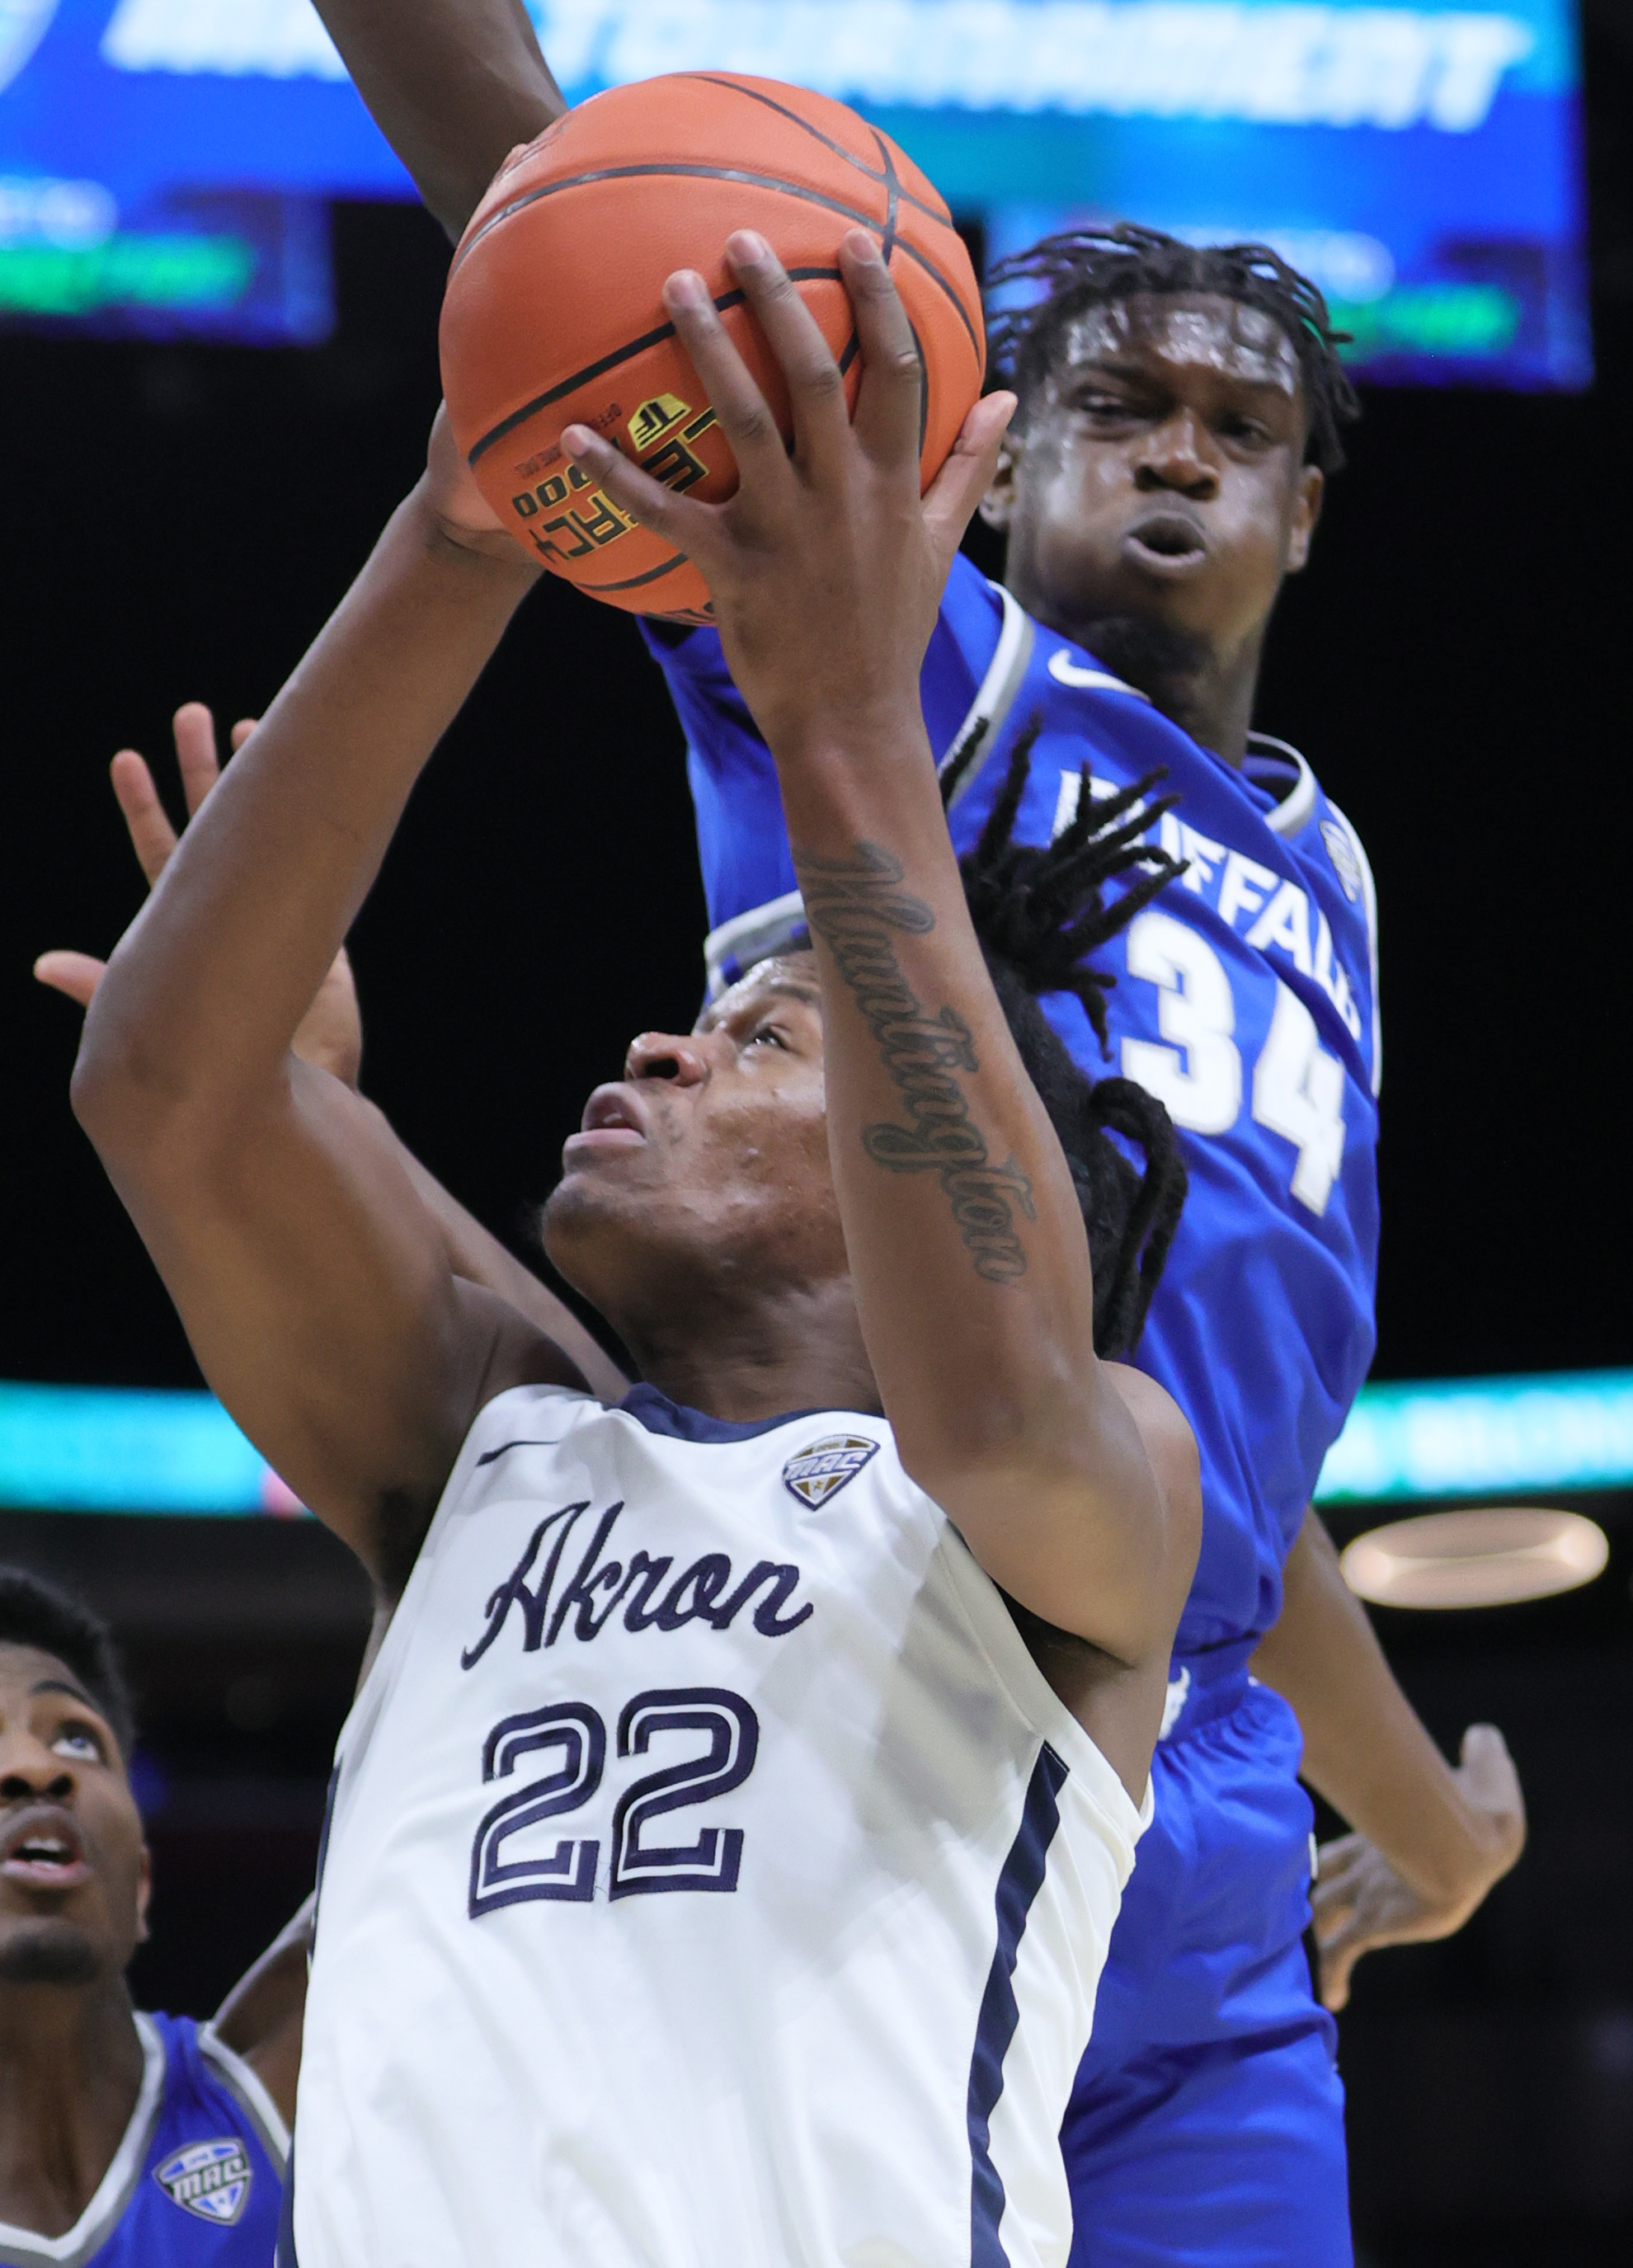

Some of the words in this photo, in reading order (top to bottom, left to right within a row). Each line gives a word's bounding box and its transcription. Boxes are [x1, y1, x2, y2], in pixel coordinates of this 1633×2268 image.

[529, 406, 718, 565] EACY
[1120, 910, 1347, 1218] 34
[784, 1452, 868, 1481] MAC
[460, 1499, 815, 1672] Akron
[468, 1687, 760, 1921] 22
[172, 2157, 252, 2204] MAC
